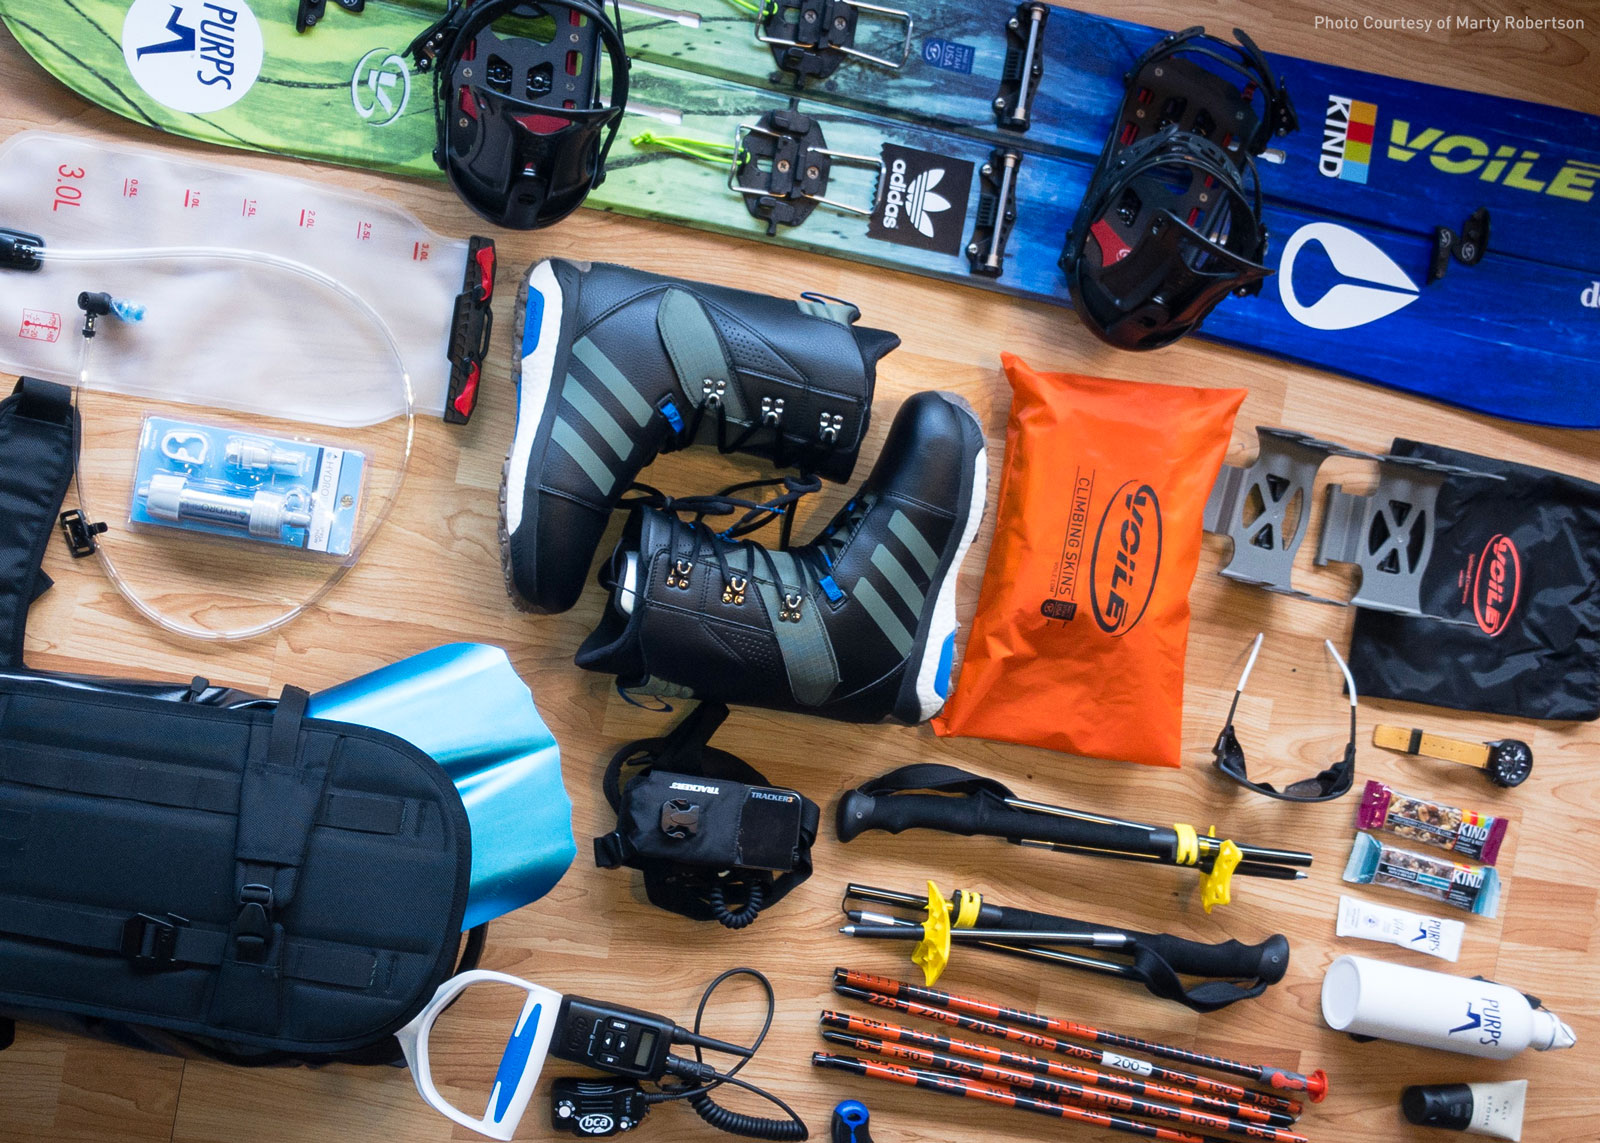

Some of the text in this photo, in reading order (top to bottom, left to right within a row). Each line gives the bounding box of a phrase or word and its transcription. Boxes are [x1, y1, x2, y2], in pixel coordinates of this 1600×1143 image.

[197, 2, 238, 90] PURPS
[944, 44, 955, 66] USA
[1318, 94, 1352, 178] KIND
[53, 164, 85, 211] 3.0L
[129, 179, 139, 198] 0.5L
[191, 191, 200, 208] 1.0L
[883, 159, 907, 228] adidas
[247, 200, 257, 217] 1.5L
[306, 210, 316, 228] 2.0L
[362, 222, 372, 240] 2.5L
[420, 243, 430, 261] 3.0L
[1580, 281, 1600, 308] d
[1059, 477, 1090, 595] CLIMBING SKINS
[1458, 823, 1488, 841] KIND
[1452, 869, 1484, 889] KIND
[1427, 919, 1442, 951] PURPS
[1480, 997, 1501, 1047] PURPS
[868, 992, 1278, 1107] 225 220 215 210 205 200 195 190 185
[893, 1047, 920, 1061] 130
[946, 1059, 971, 1073] 125
[996, 1071, 1021, 1084] 120
[1046, 1082, 1071, 1095] 115
[1095, 1093, 1120, 1106] 110
[1143, 1103, 1169, 1117] 105
[584, 1116, 608, 1127] bca
